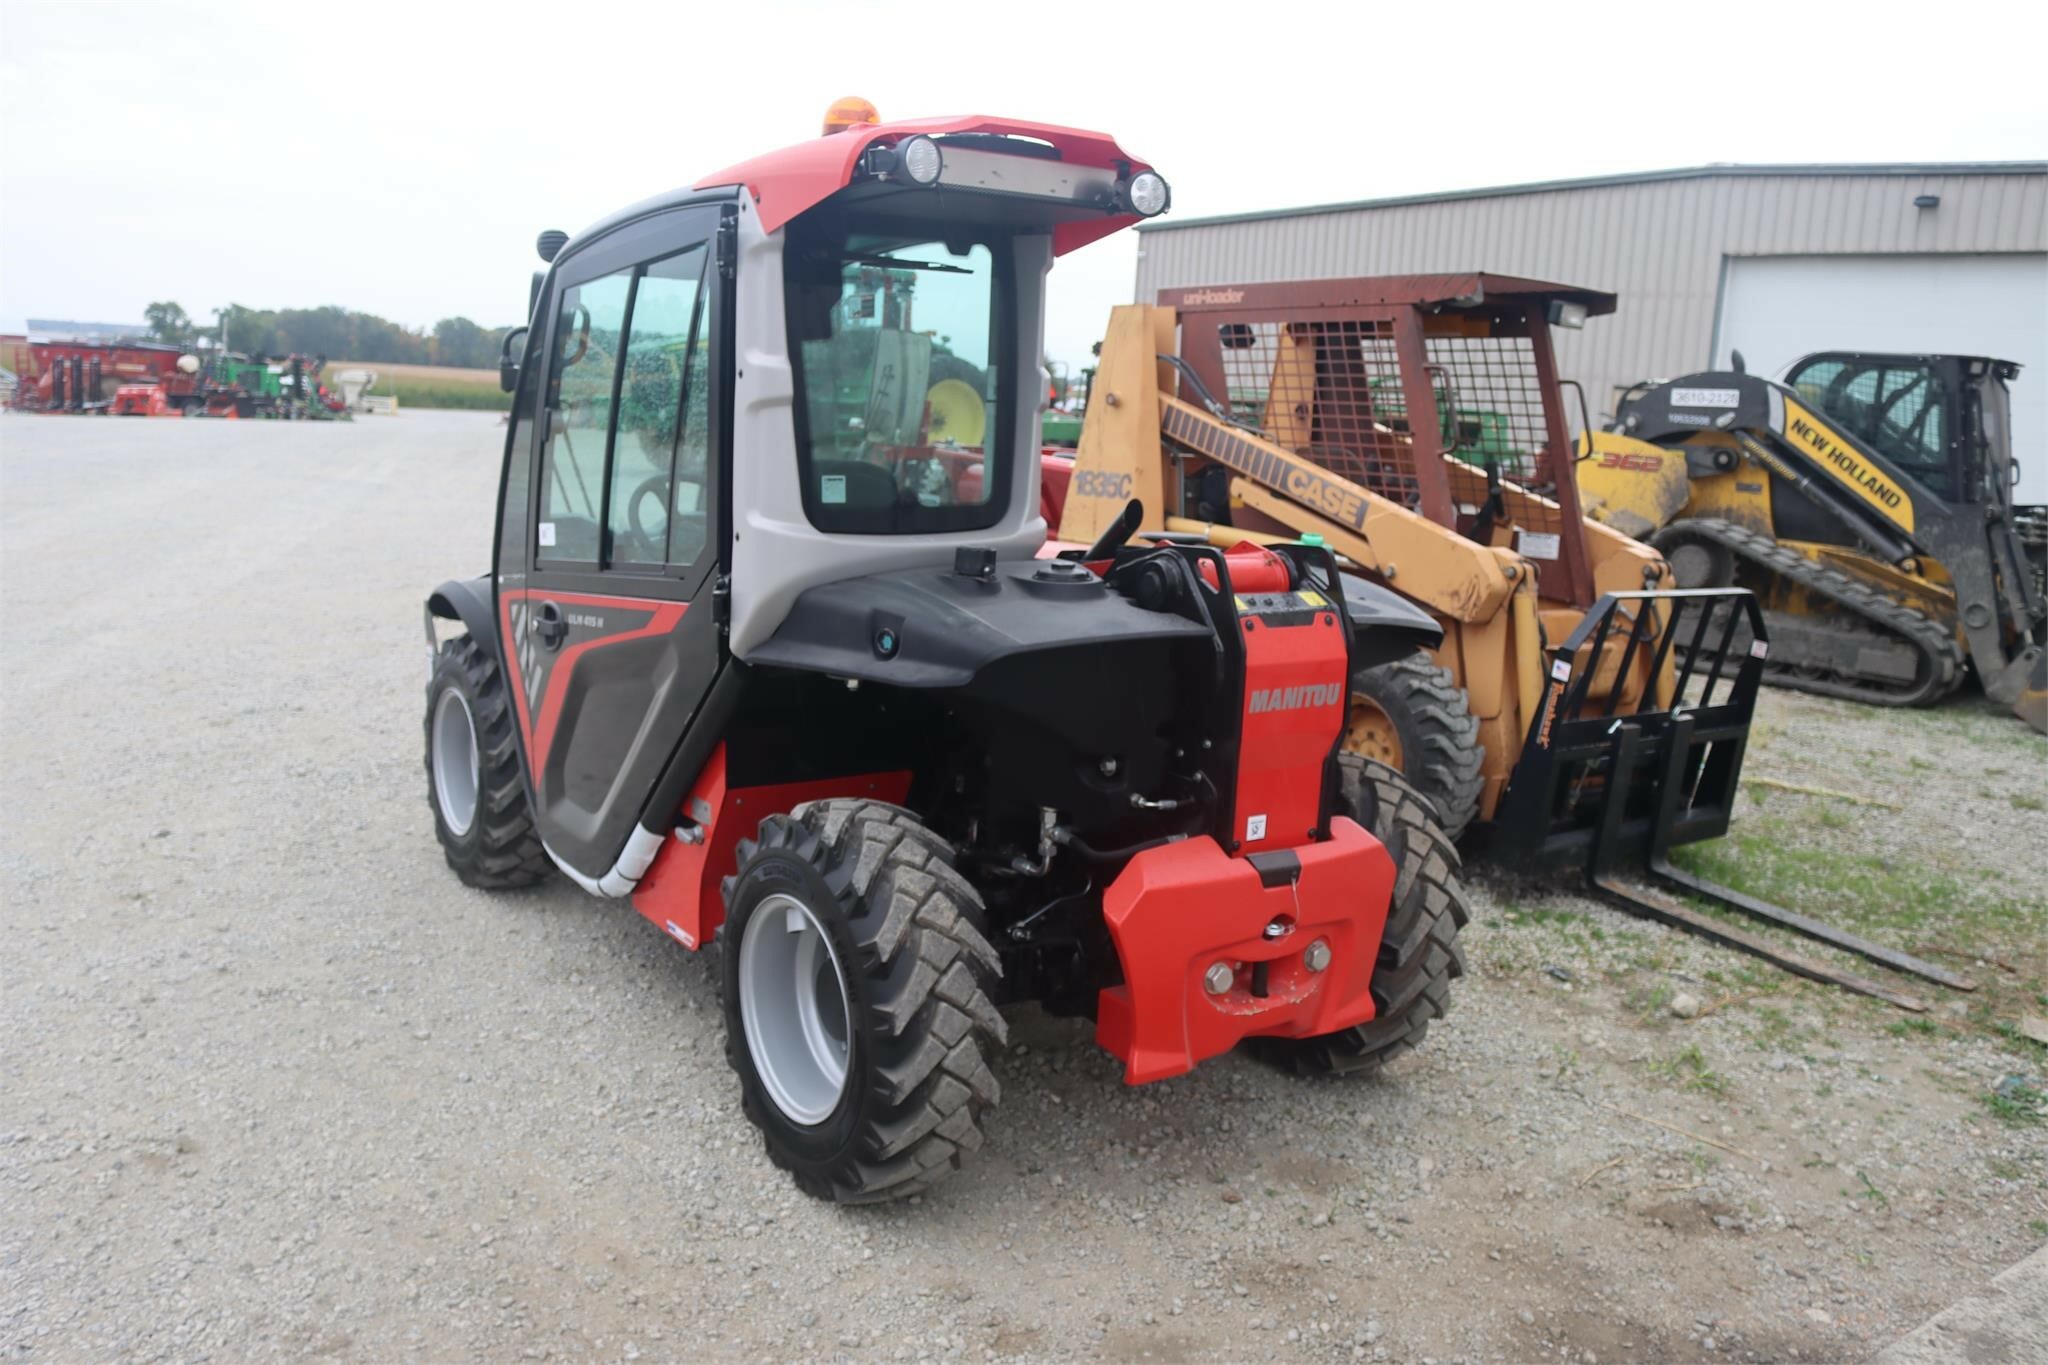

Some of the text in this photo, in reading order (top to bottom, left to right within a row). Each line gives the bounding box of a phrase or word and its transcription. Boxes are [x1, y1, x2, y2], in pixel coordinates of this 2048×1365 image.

[1076, 469, 1132, 500] 1835C
[1791, 418, 1829, 452] NEW
[1827, 446, 1901, 508] HOLLAND
[1287, 470, 1362, 525] CASE
[1248, 682, 1342, 715] MANITOU
